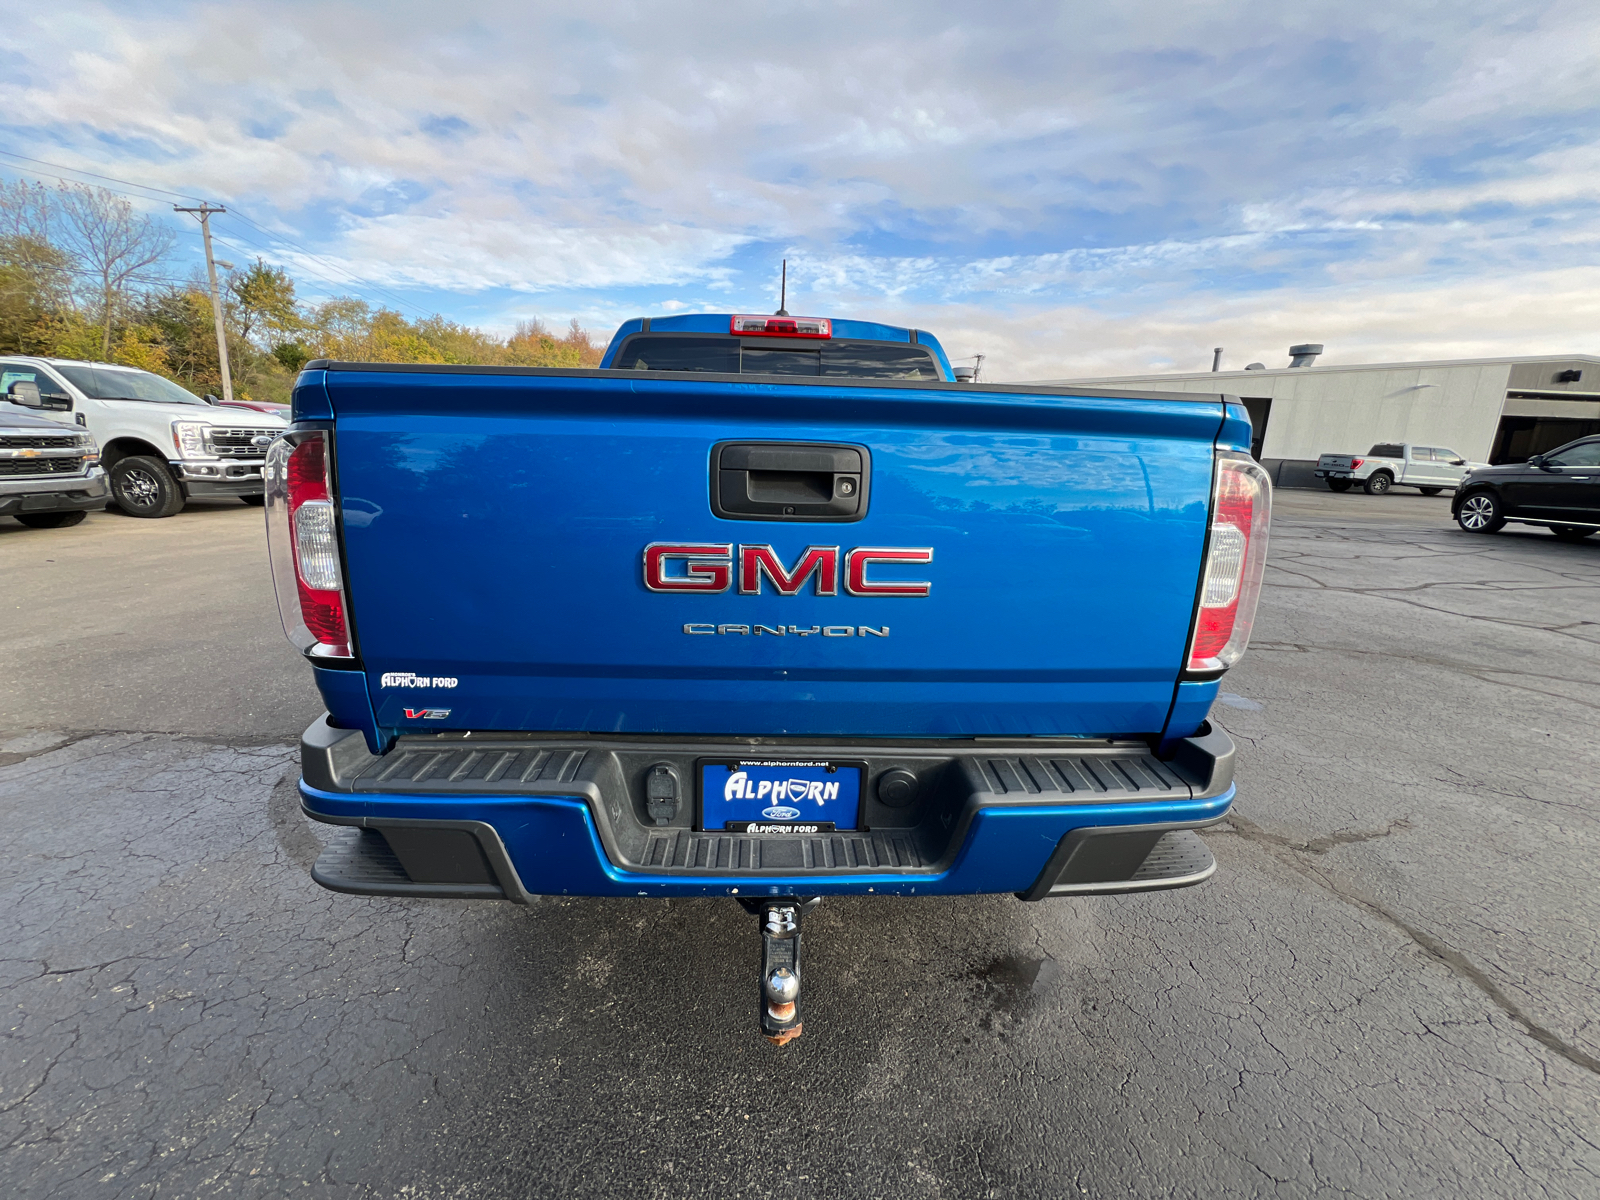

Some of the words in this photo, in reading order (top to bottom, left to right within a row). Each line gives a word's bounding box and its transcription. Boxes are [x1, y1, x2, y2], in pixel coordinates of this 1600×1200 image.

[642, 541, 934, 598] GMC
[683, 623, 890, 637] CANYON
[432, 677, 458, 688] FORD
[402, 707, 452, 719] V6
[793, 825, 818, 834] FORD
